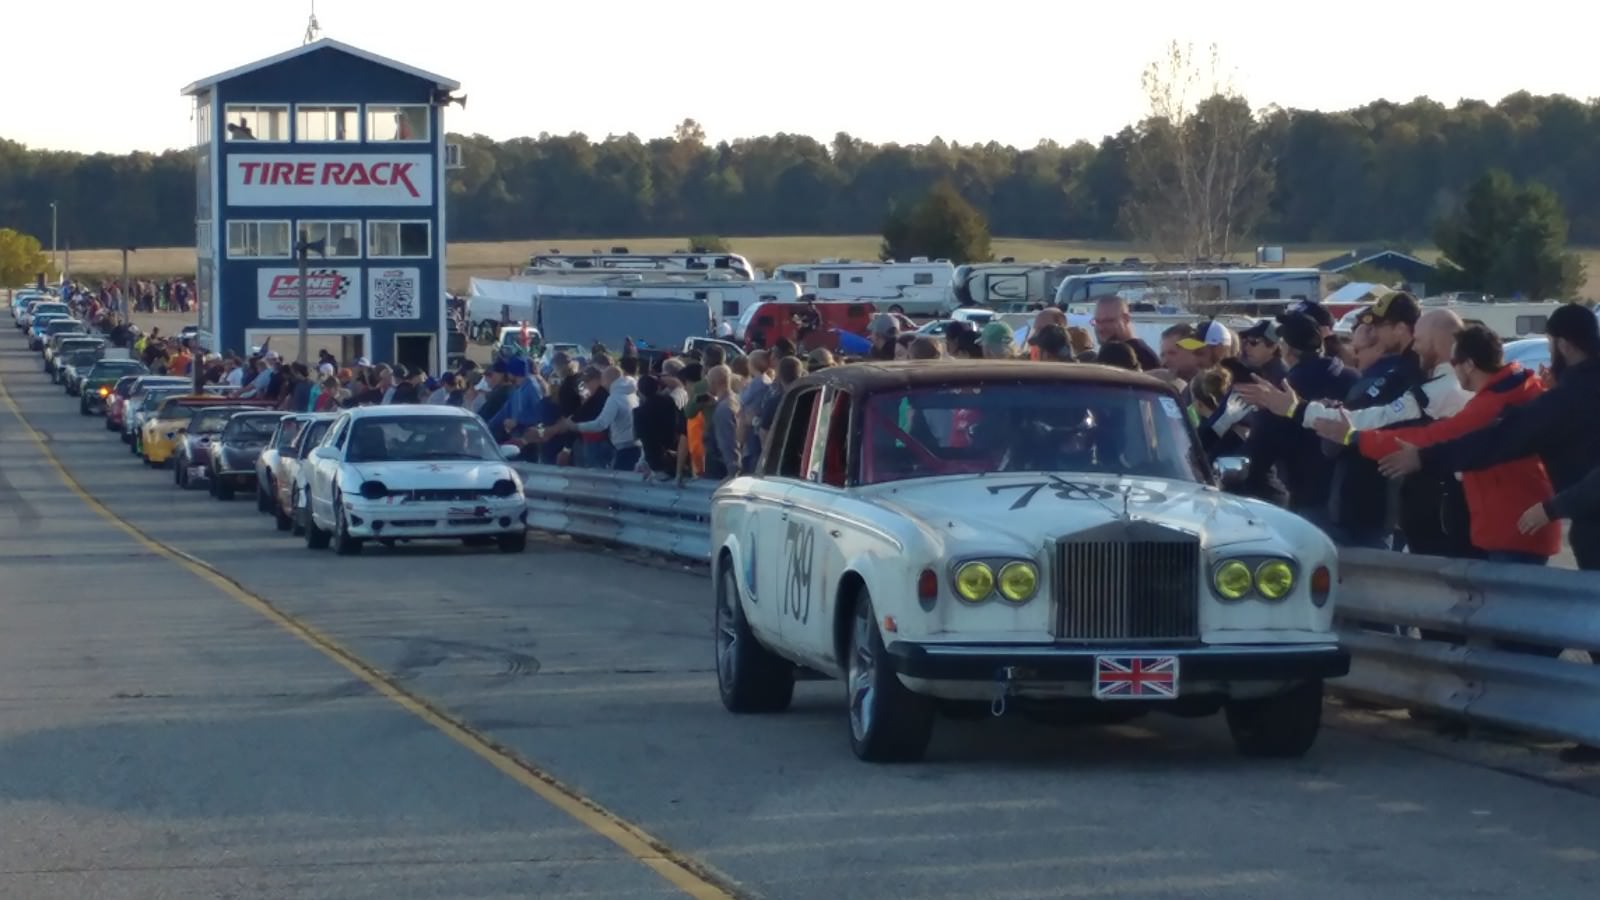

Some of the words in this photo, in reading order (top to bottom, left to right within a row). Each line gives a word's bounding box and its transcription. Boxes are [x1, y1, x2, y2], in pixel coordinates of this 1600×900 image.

[238, 162, 316, 185] TIRE
[321, 162, 421, 198] RACK
[277, 277, 337, 289] LANE
[986, 481, 1168, 511] 789
[784, 520, 815, 625] 789
